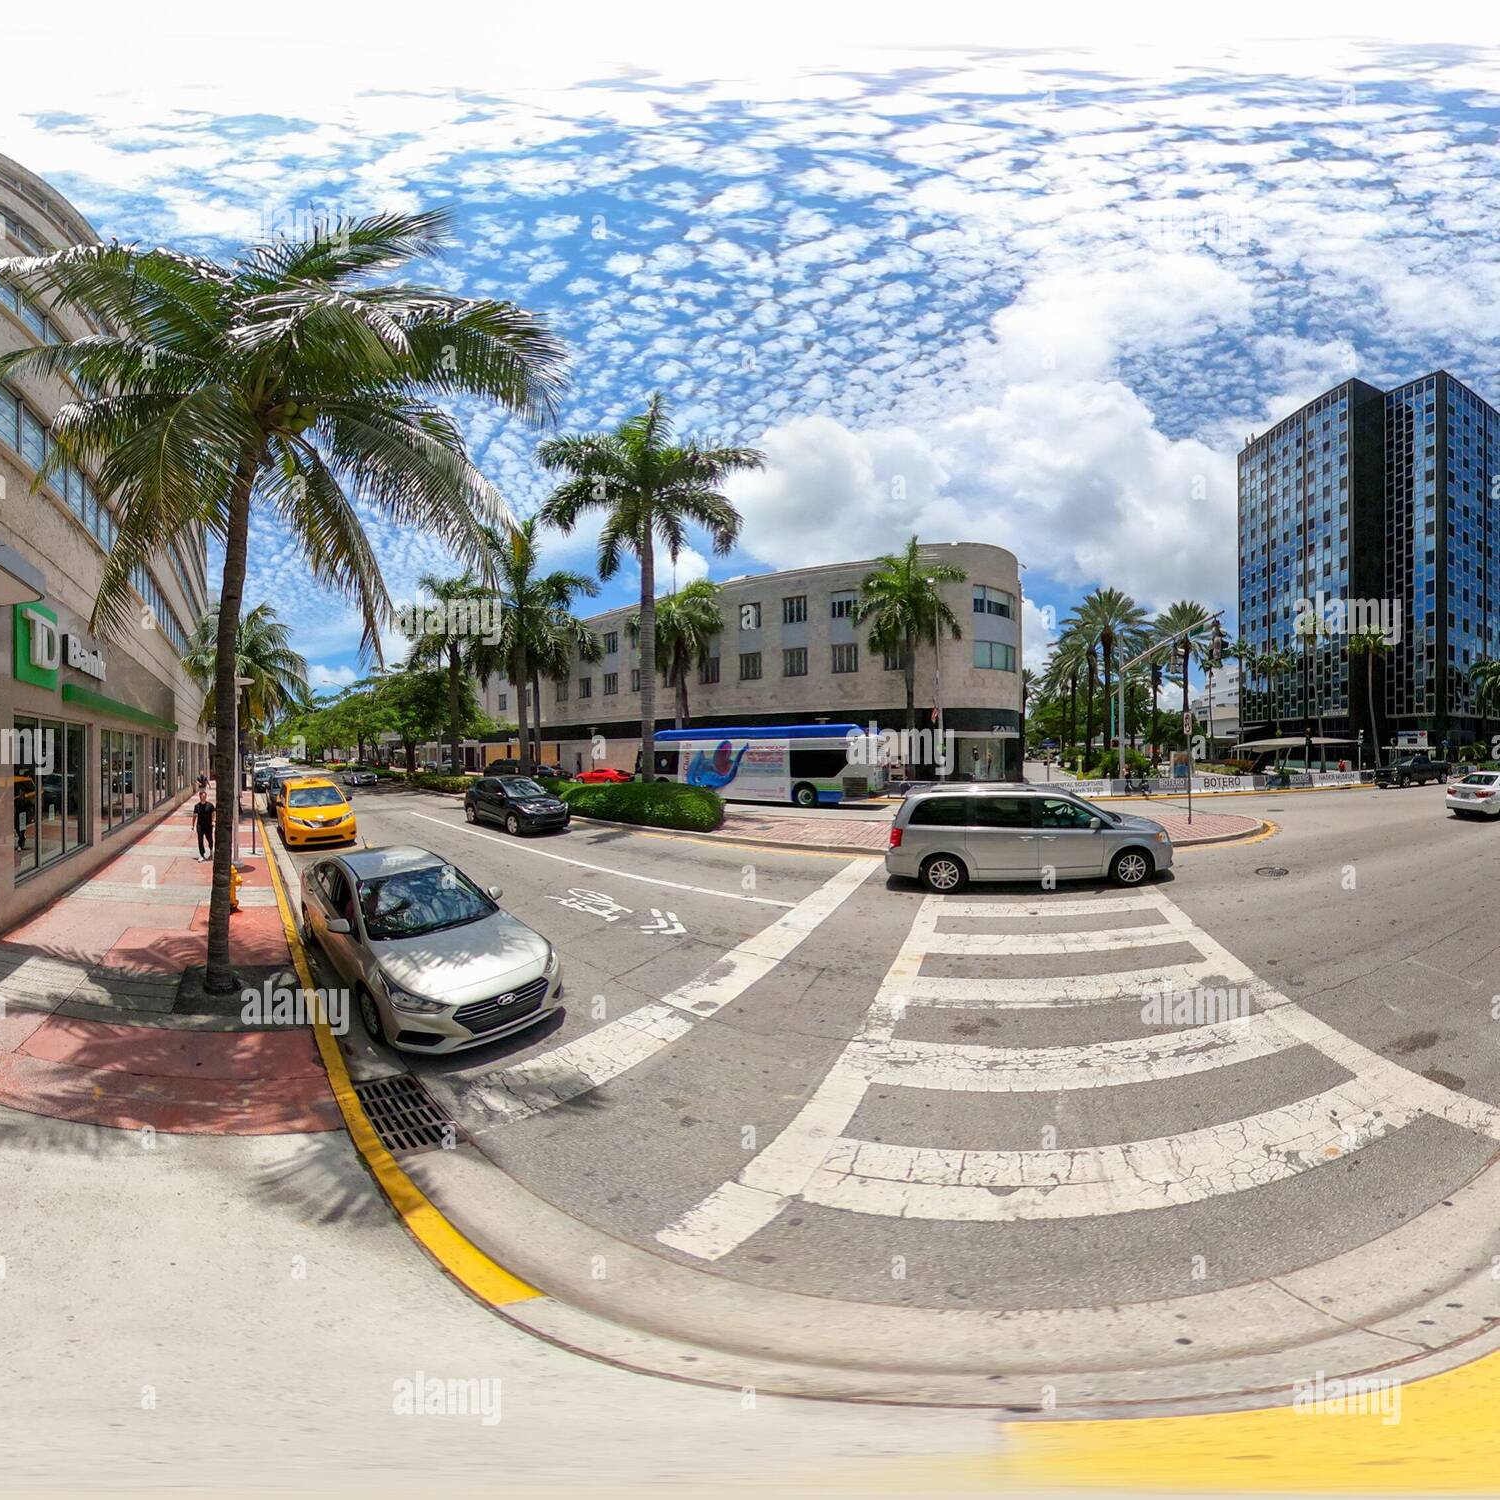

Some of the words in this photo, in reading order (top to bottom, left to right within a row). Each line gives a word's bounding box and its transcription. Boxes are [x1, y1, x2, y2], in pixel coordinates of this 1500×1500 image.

[22, 608, 60, 670] TD
[63, 634, 107, 681] Bank
[1158, 778, 1185, 786] BOTERO
[1203, 777, 1241, 788] BOTERO
